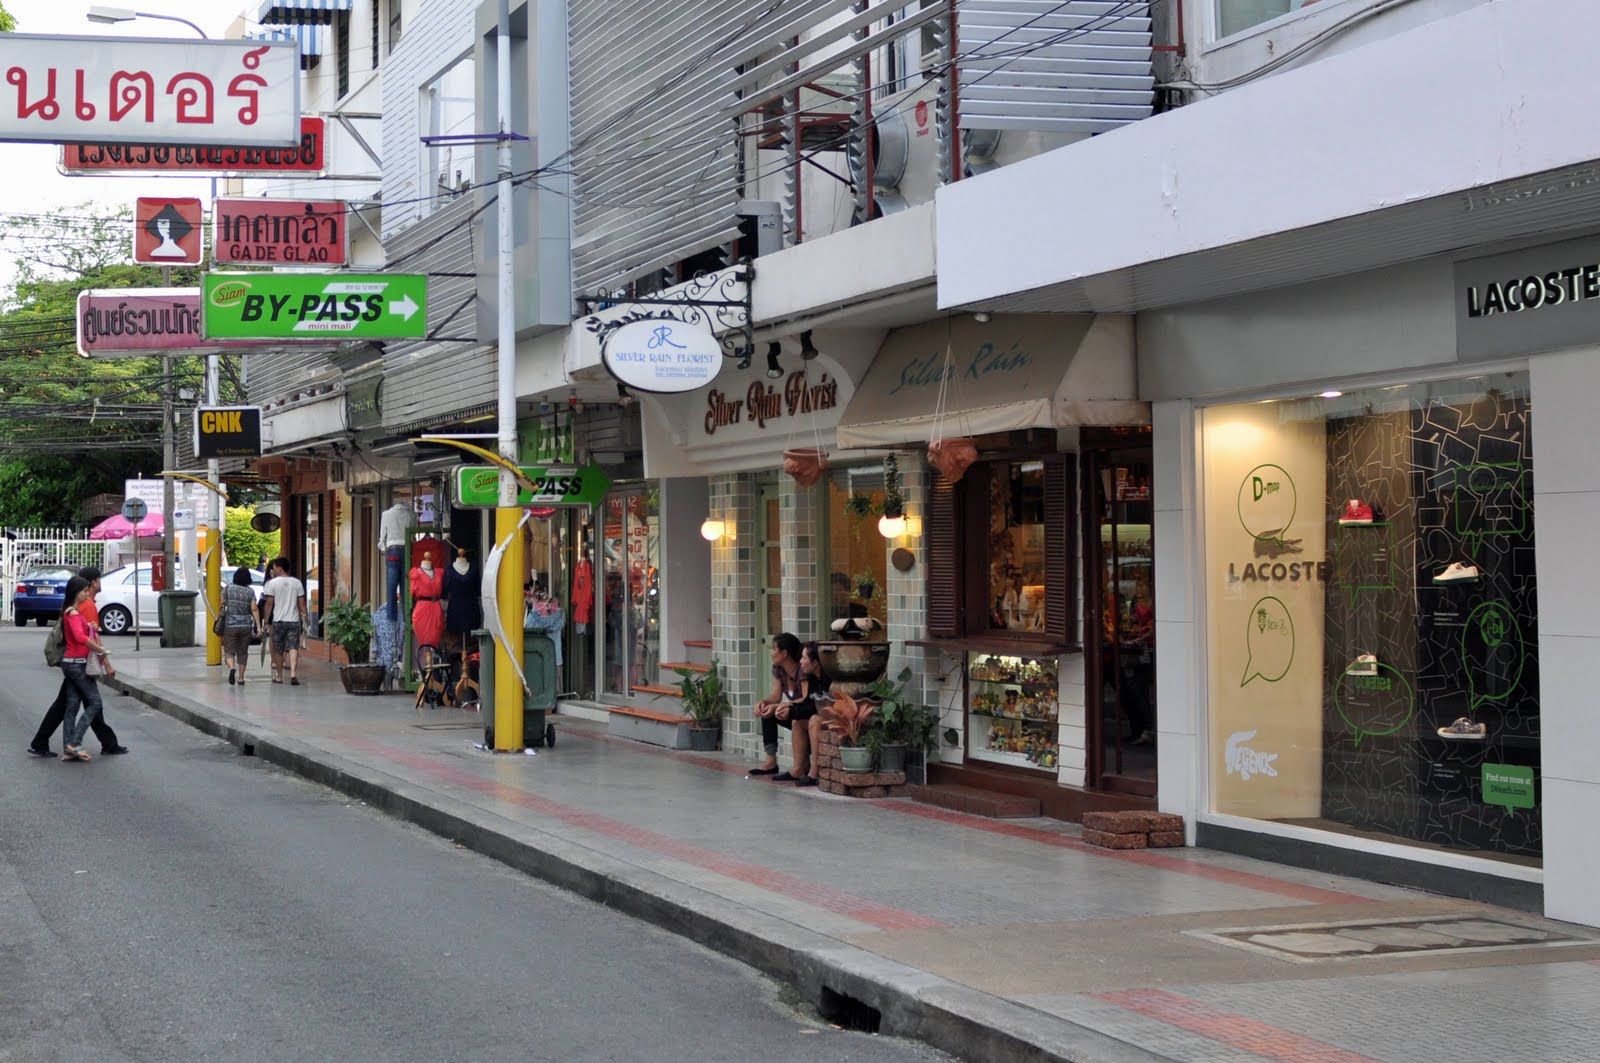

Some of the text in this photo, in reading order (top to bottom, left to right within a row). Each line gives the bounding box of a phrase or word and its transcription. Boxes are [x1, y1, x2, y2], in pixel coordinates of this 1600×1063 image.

[216, 286, 246, 304] Siam
[1467, 264, 1600, 318] LACOSTE
[240, 294, 384, 322] BY-PASS
[308, 321, 352, 331] mini mall
[615, 351, 715, 364] SILVER RAIN FLORIST
[704, 370, 838, 435] Silver Rain Florist
[201, 411, 243, 434] CNK
[1228, 561, 1328, 583] LACOSTE
[1485, 772, 1499, 782] Find
